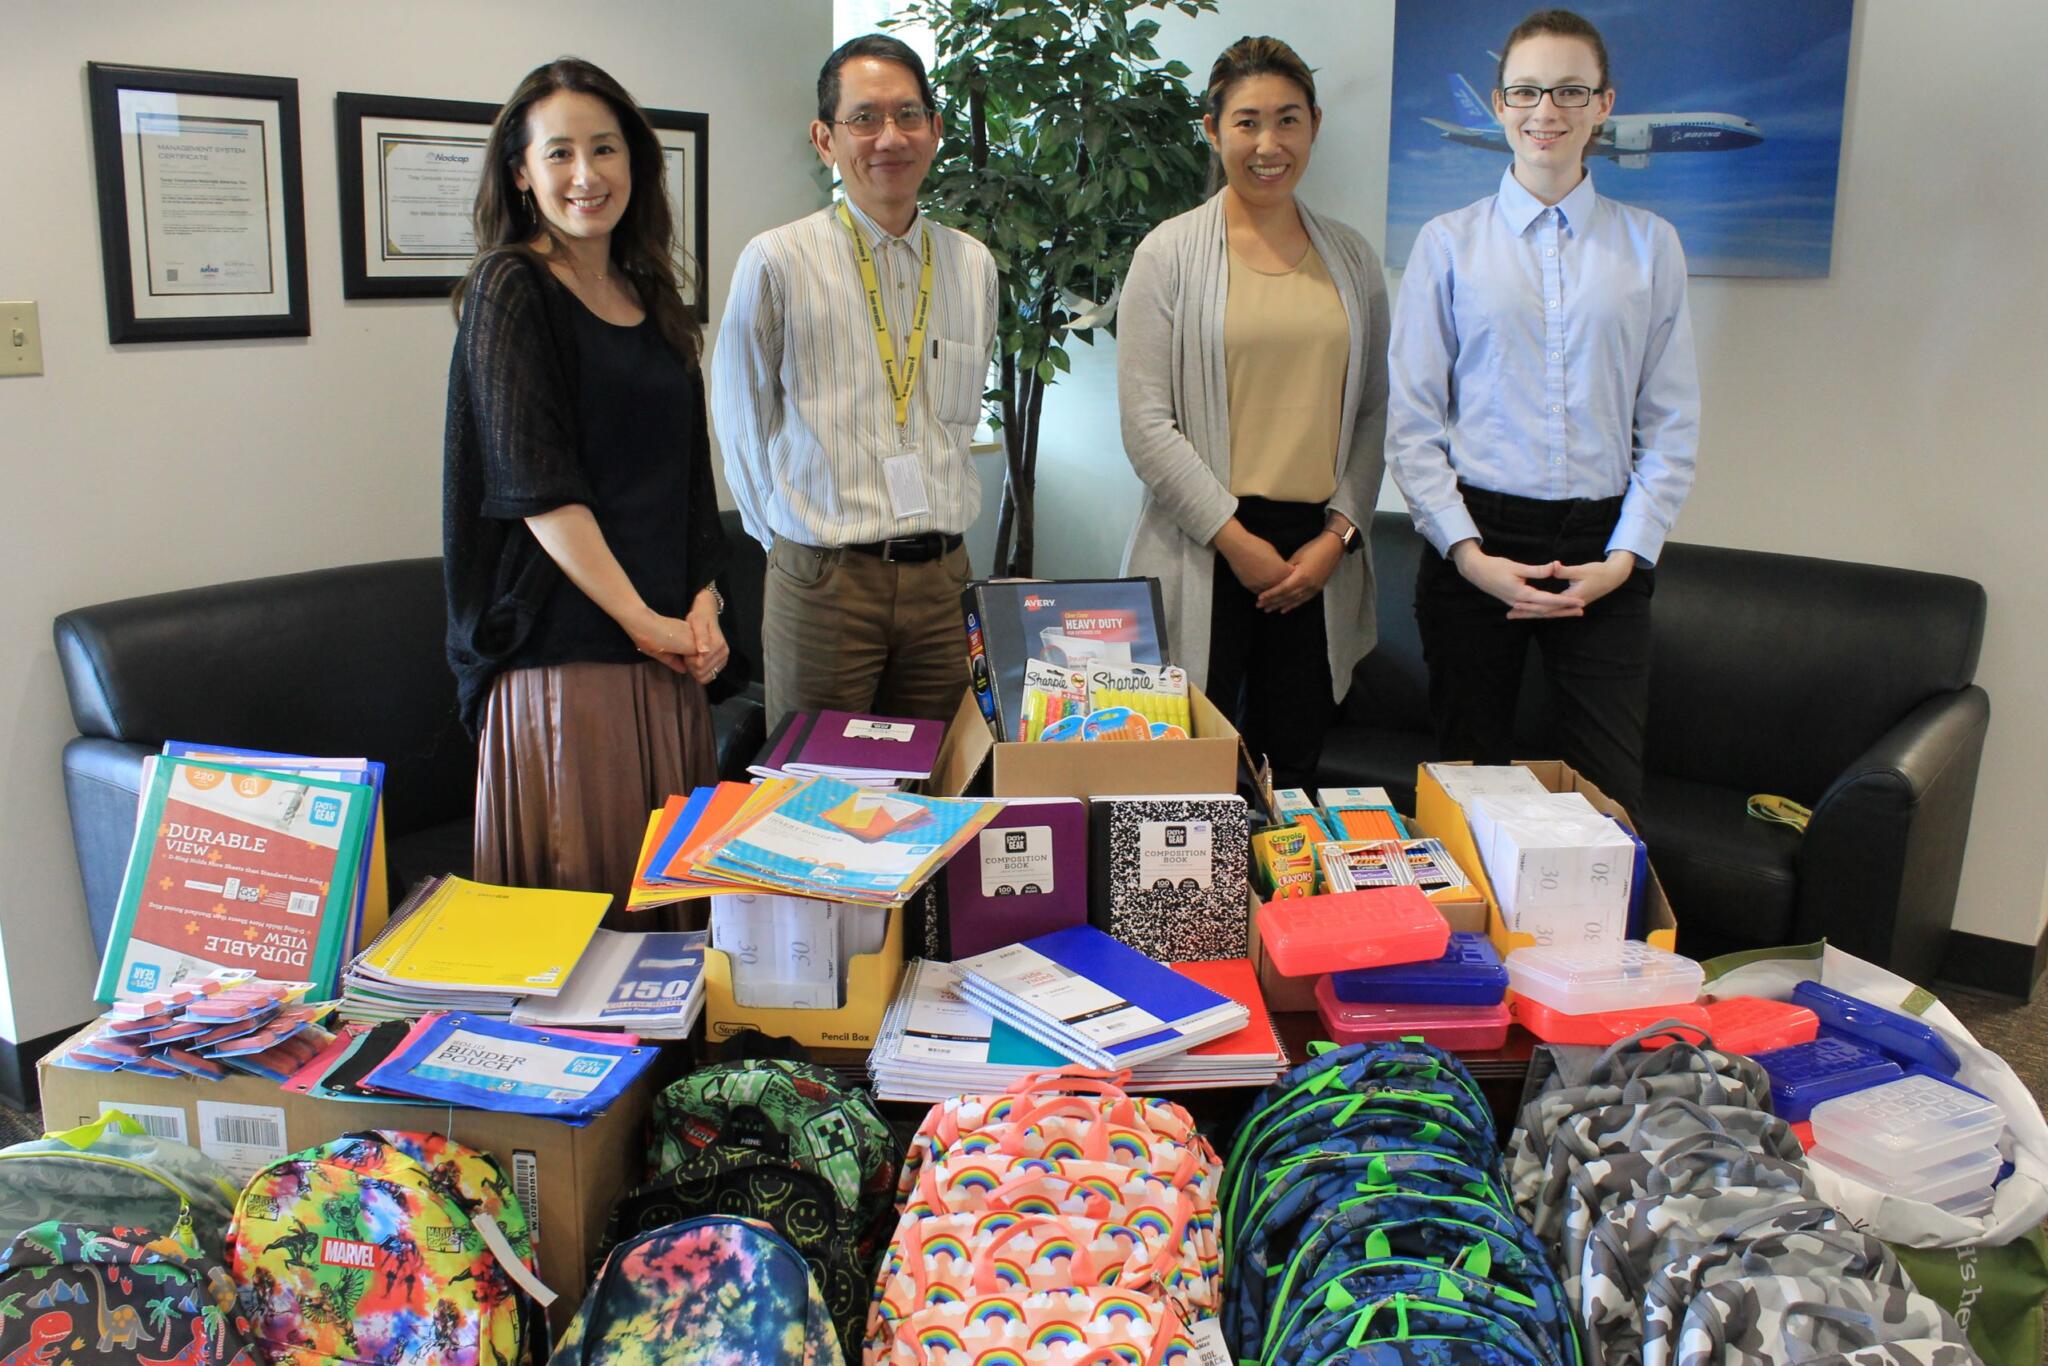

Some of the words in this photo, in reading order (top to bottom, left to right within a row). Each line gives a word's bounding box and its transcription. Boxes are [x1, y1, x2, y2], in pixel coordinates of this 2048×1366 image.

[1024, 599, 1055, 607] AVERY
[1065, 618, 1096, 630] HEAVY
[1099, 618, 1123, 629] DUTY
[1025, 672, 1068, 690] Sharpie
[1093, 671, 1154, 692] Sharpie
[167, 823, 268, 853] DURABLE
[1008, 841, 1025, 850] GEAR
[1168, 835, 1184, 844] GEAR
[1272, 832, 1304, 843] Crayola
[166, 839, 209, 856] VIEW
[985, 855, 1047, 864] COMPOSITION
[1004, 862, 1029, 870] BOOK
[1278, 872, 1312, 887] CRAYONS
[1539, 866, 1559, 890] 30
[1591, 863, 1610, 886] 30
[263, 932, 309, 950] VIEW
[204, 935, 308, 967] DURABLE
[738, 941, 758, 965] 30
[792, 941, 811, 967] 30
[618, 979, 690, 999] 150
[452, 1040, 486, 1049] SOLID
[821, 1032, 849, 1041] Pencil
[852, 1033, 870, 1041] Box
[437, 1052, 514, 1072] POUCH
[446, 1045, 527, 1065] BINDER
[571, 1064, 601, 1075] GEAR
[324, 1241, 376, 1267] MARVEL
